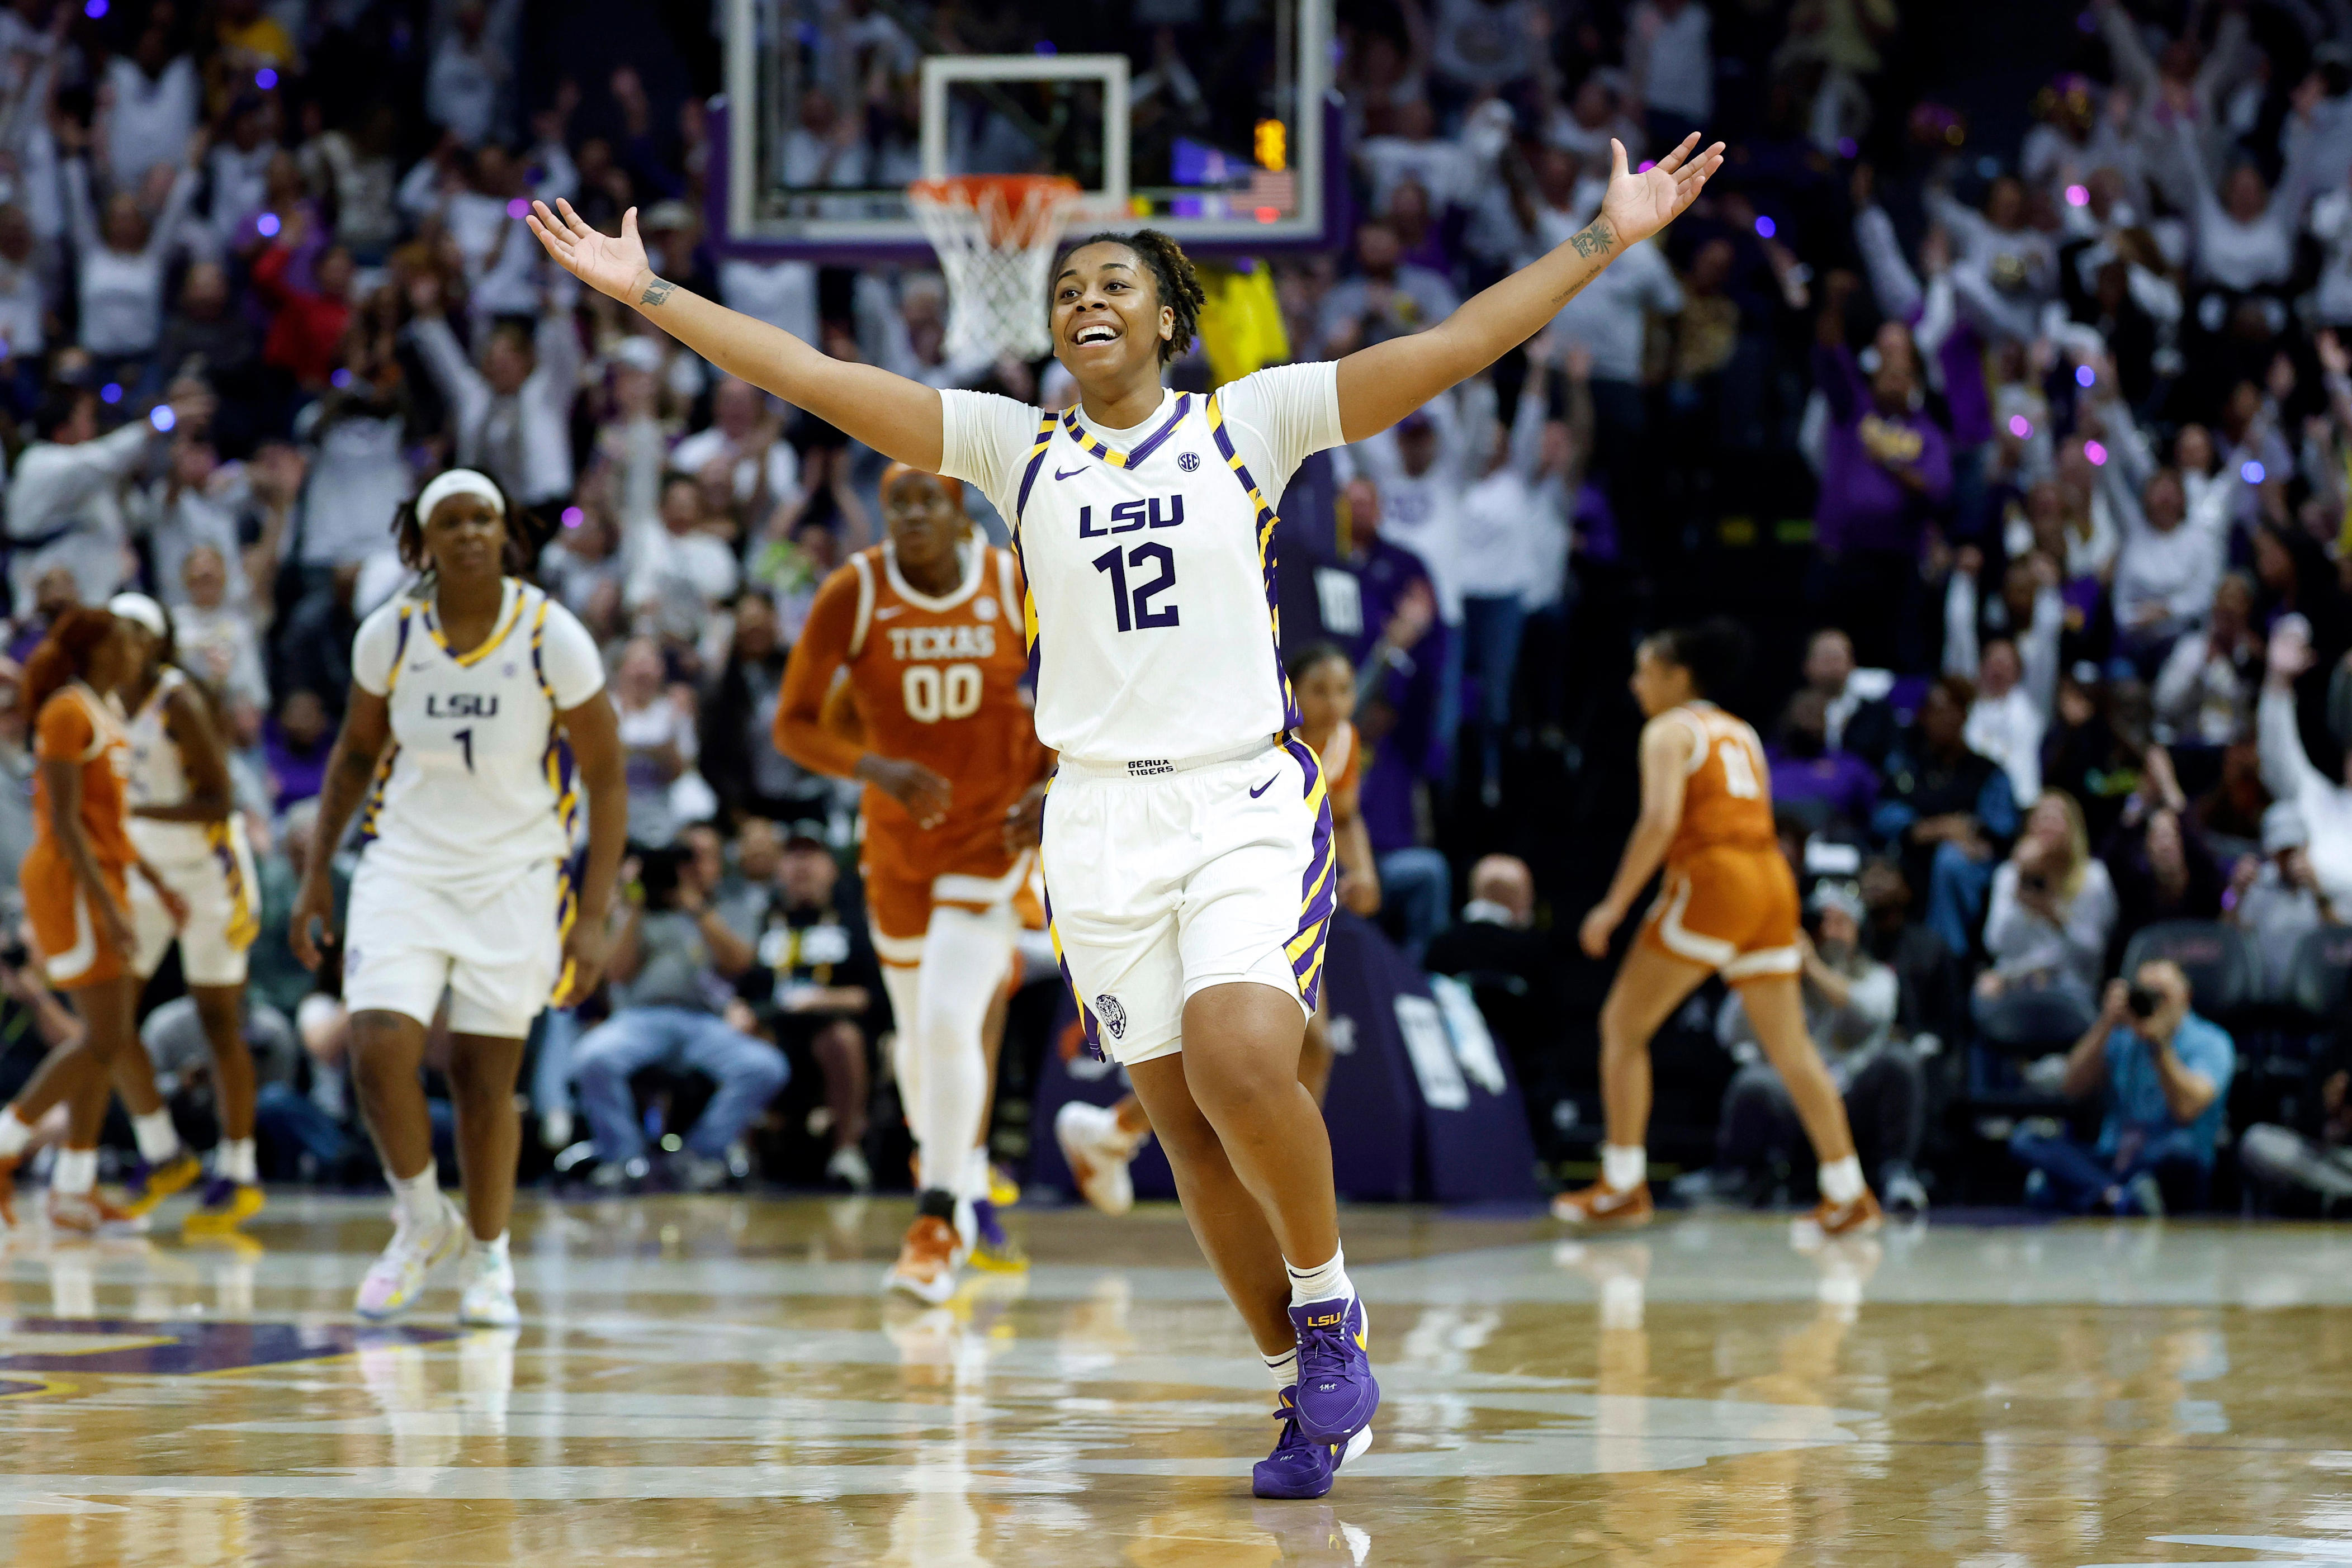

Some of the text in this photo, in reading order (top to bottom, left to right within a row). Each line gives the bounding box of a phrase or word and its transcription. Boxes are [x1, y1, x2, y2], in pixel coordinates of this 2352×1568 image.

[1180, 453, 1198, 470] SEC
[1080, 494, 1184, 539] LSU
[1092, 541, 1180, 633] 12
[888, 625, 996, 660] TEXAS
[427, 694, 498, 718] LSU
[902, 664, 983, 723] 00
[453, 728, 474, 773] 1
[1128, 760, 1170, 768] GEAUX
[1128, 766, 1173, 776] TIGERS
[1307, 1312, 1341, 1327] LSU
